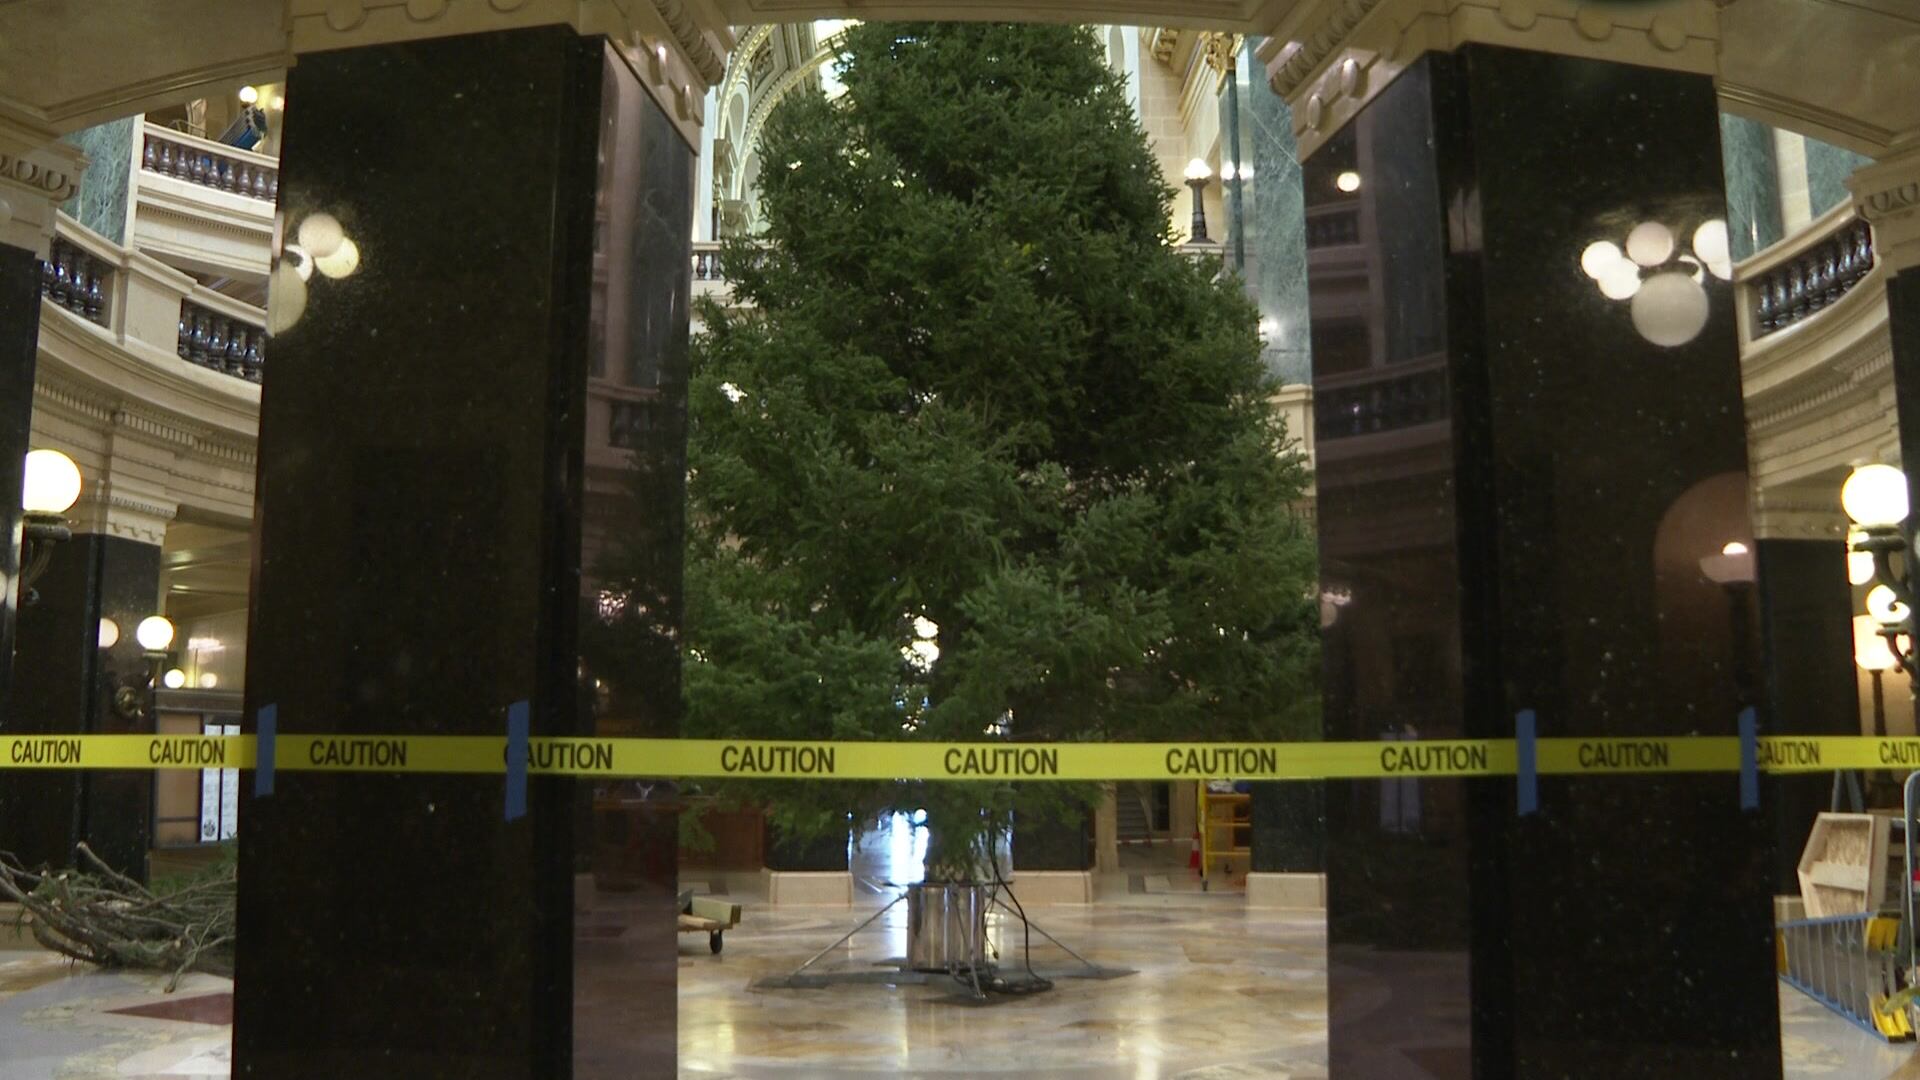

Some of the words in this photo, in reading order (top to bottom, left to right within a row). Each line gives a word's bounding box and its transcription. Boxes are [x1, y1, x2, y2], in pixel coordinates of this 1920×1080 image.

[11, 741, 81, 763] CAUTION
[149, 740, 225, 764] CAUTION
[309, 740, 407, 766] CAUTION
[504, 742, 613, 769] UTION
[721, 745, 834, 774] CAUTION
[944, 747, 1058, 776] CAUTION
[1166, 747, 1277, 775] CAUTION
[1381, 745, 1487, 771] CAUTION
[1578, 743, 1669, 768] CAUTION
